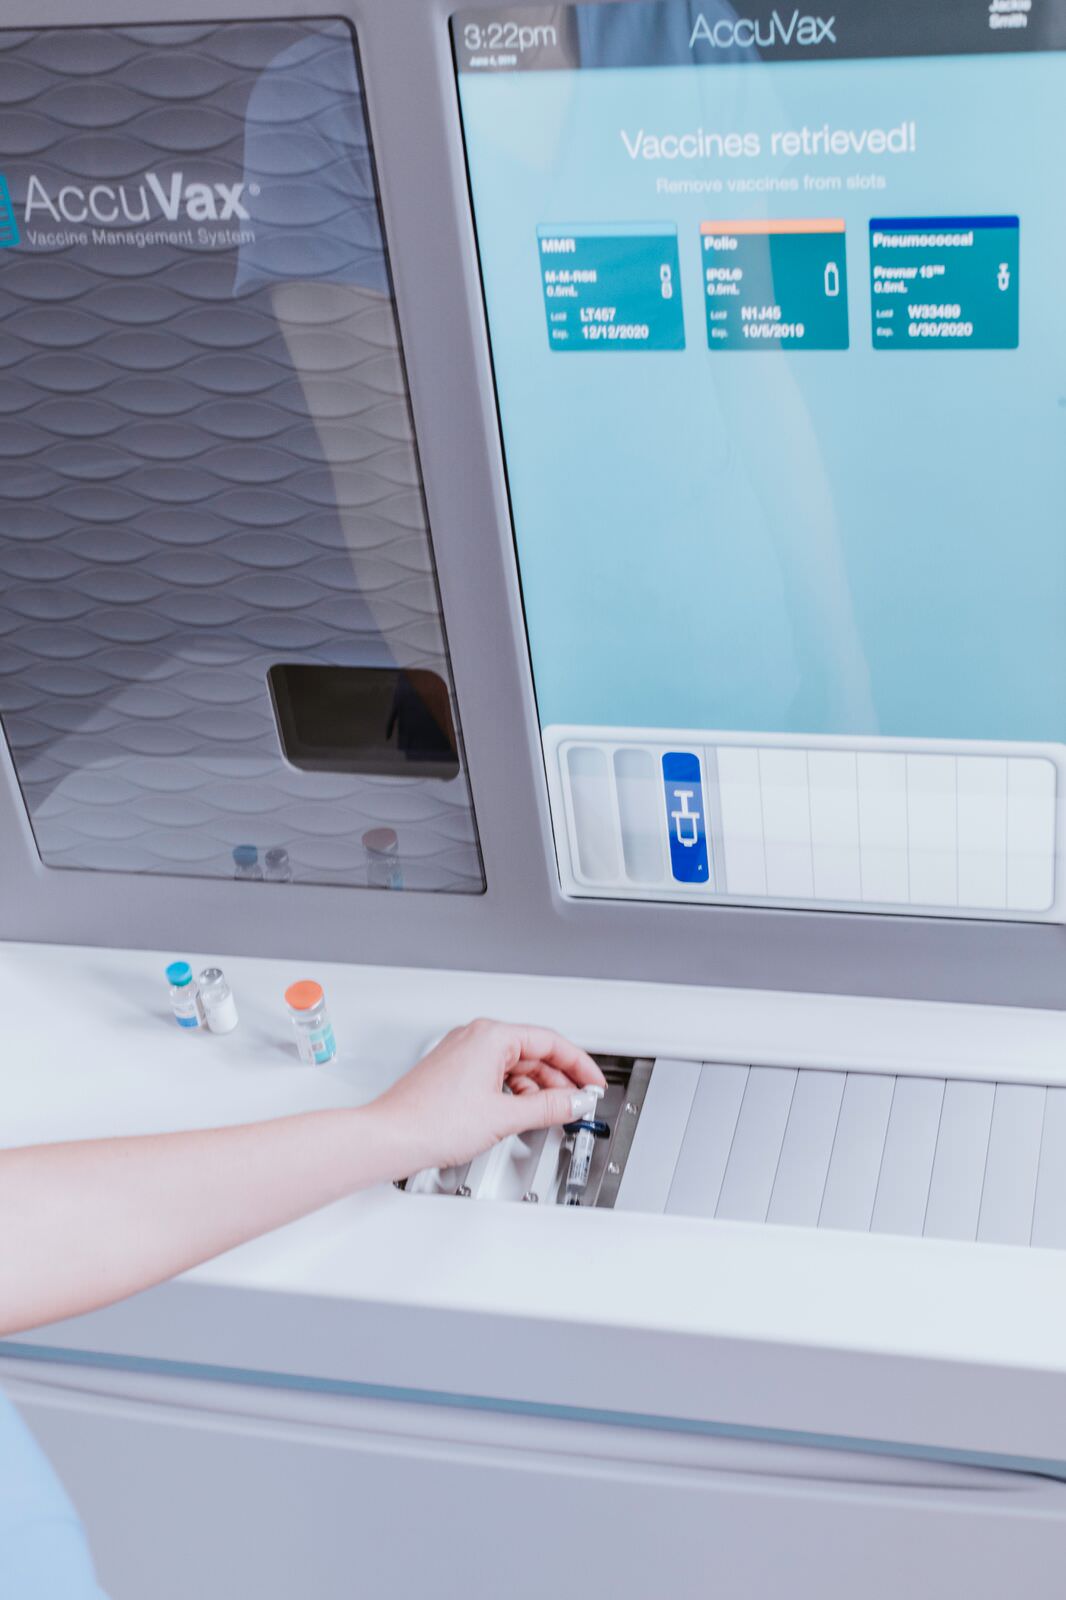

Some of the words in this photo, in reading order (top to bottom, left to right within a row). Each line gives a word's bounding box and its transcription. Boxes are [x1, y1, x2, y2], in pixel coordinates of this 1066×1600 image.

[464, 22, 557, 53] 3:22pm
[689, 10, 837, 48] AccuVax
[621, 128, 760, 161] Vaccines
[770, 120, 917, 156] retrieved!
[656, 178, 722, 195] Remove
[728, 176, 798, 193] vaccines
[803, 175, 842, 191] from
[846, 173, 887, 190] slots
[26, 230, 88, 246] Vaccine
[92, 228, 193, 248] Management
[198, 227, 256, 247] System
[542, 238, 576, 253] MMR
[704, 236, 738, 251] Polio
[873, 231, 973, 248] Pneumococcal
[581, 325, 649, 340] 12/12/2020
[908, 322, 973, 337] 6/30/2020
